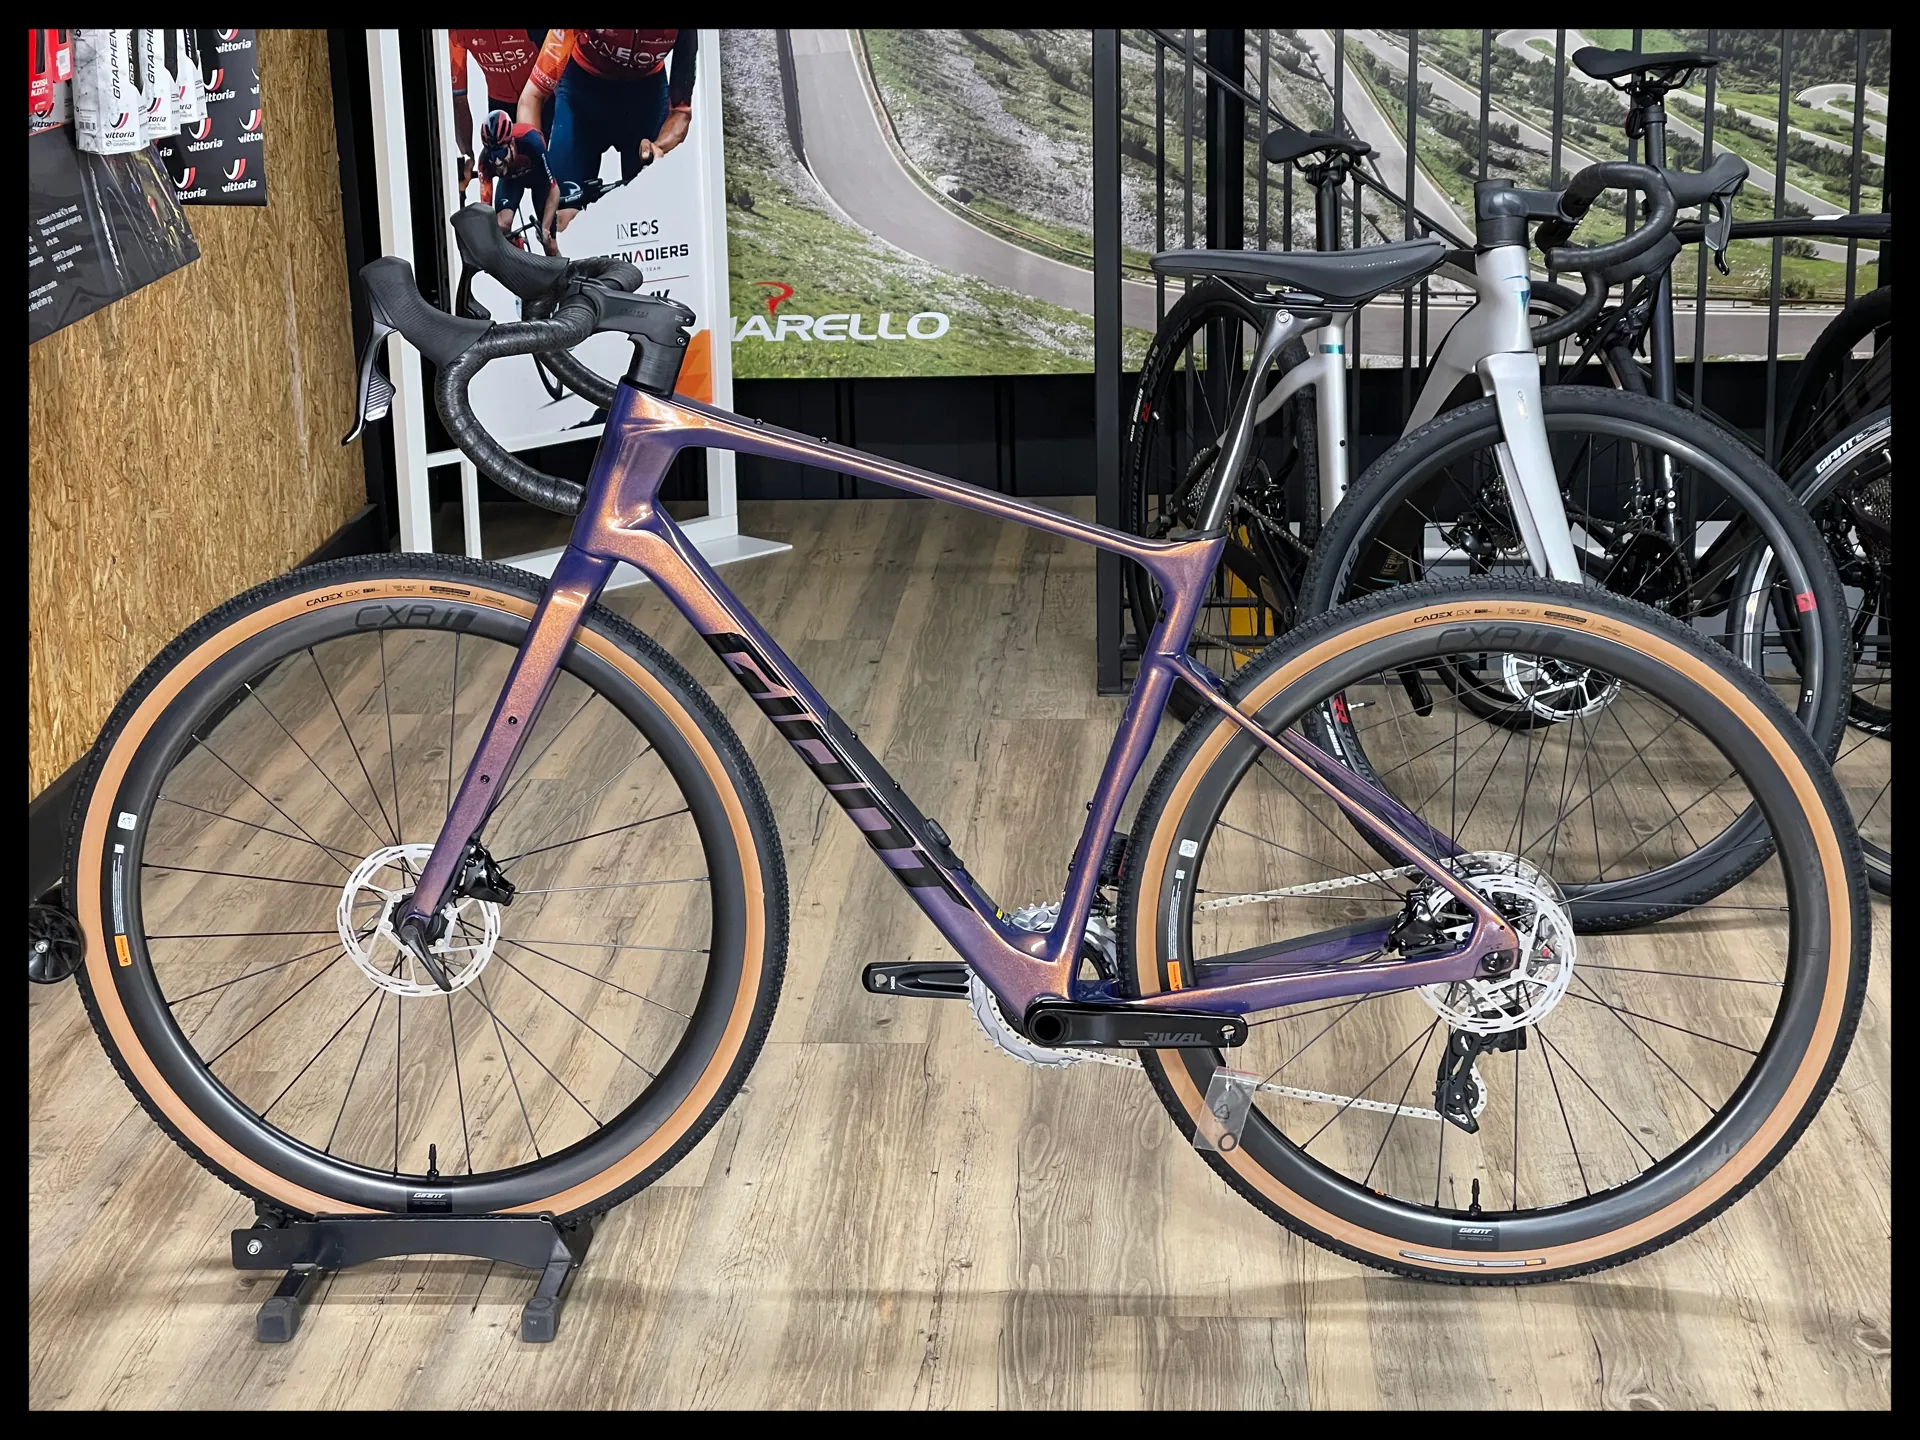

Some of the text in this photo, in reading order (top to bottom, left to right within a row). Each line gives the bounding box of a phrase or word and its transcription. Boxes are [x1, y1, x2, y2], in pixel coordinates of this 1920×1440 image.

[216, 39, 252, 53] vittoria
[478, 48, 526, 63] INEOS
[205, 90, 236, 103] ittoria
[149, 115, 167, 123] toria
[105, 131, 135, 139] vittoria
[188, 139, 224, 152] vittoria
[222, 180, 258, 193] vittoria
[177, 188, 208, 201] ittoria
[616, 219, 659, 240] INEOS
[730, 311, 950, 342] ARELLO
[1815, 435, 1858, 475] GIANT
[306, 592, 343, 607] CADEX
[345, 589, 360, 597] GX
[355, 604, 436, 628] CXR
[1414, 611, 1453, 624] CADEX
[1144, 1032, 1204, 1043] RIVAL
[1458, 1227, 1493, 1235] GIANT
